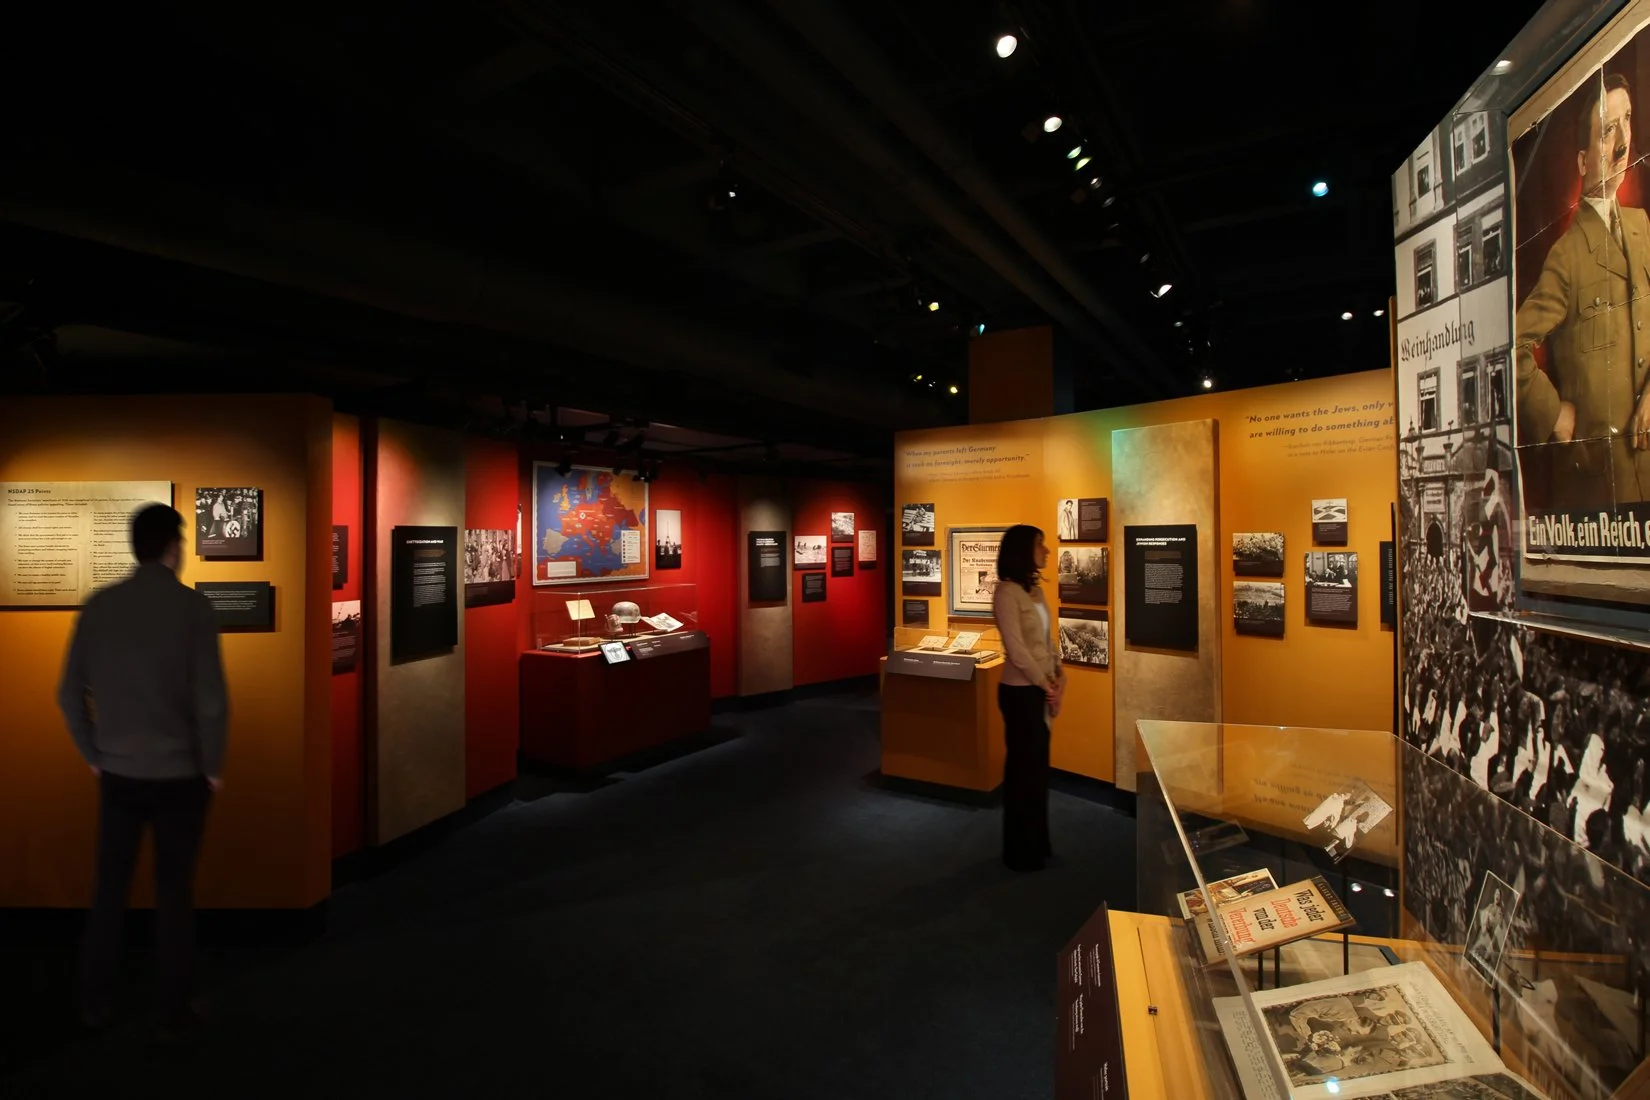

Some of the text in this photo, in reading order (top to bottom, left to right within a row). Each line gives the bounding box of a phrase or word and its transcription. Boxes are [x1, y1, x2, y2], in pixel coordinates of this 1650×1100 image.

[1401, 320, 1475, 362] Weinhandlung
[1283, 410, 1310, 419] wants
[1313, 408, 1329, 416] the
[1331, 405, 1359, 414] Jews,
[1362, 400, 1386, 411] only
[1266, 426, 1296, 437] willing
[1311, 424, 1323, 432] do
[1325, 418, 1380, 431] something
[1529, 516, 1546, 546] Ein
[1544, 514, 1578, 548] Volk,
[1578, 516, 1599, 547] ein
[1600, 511, 1644, 550] Reich,
[962, 543, 973, 552] Der
[1254, 908, 1275, 931] von der
[1270, 898, 1300, 928] Deutsche
[1294, 888, 1324, 922] Was jeder
[1228, 908, 1256, 944] Vererbung
